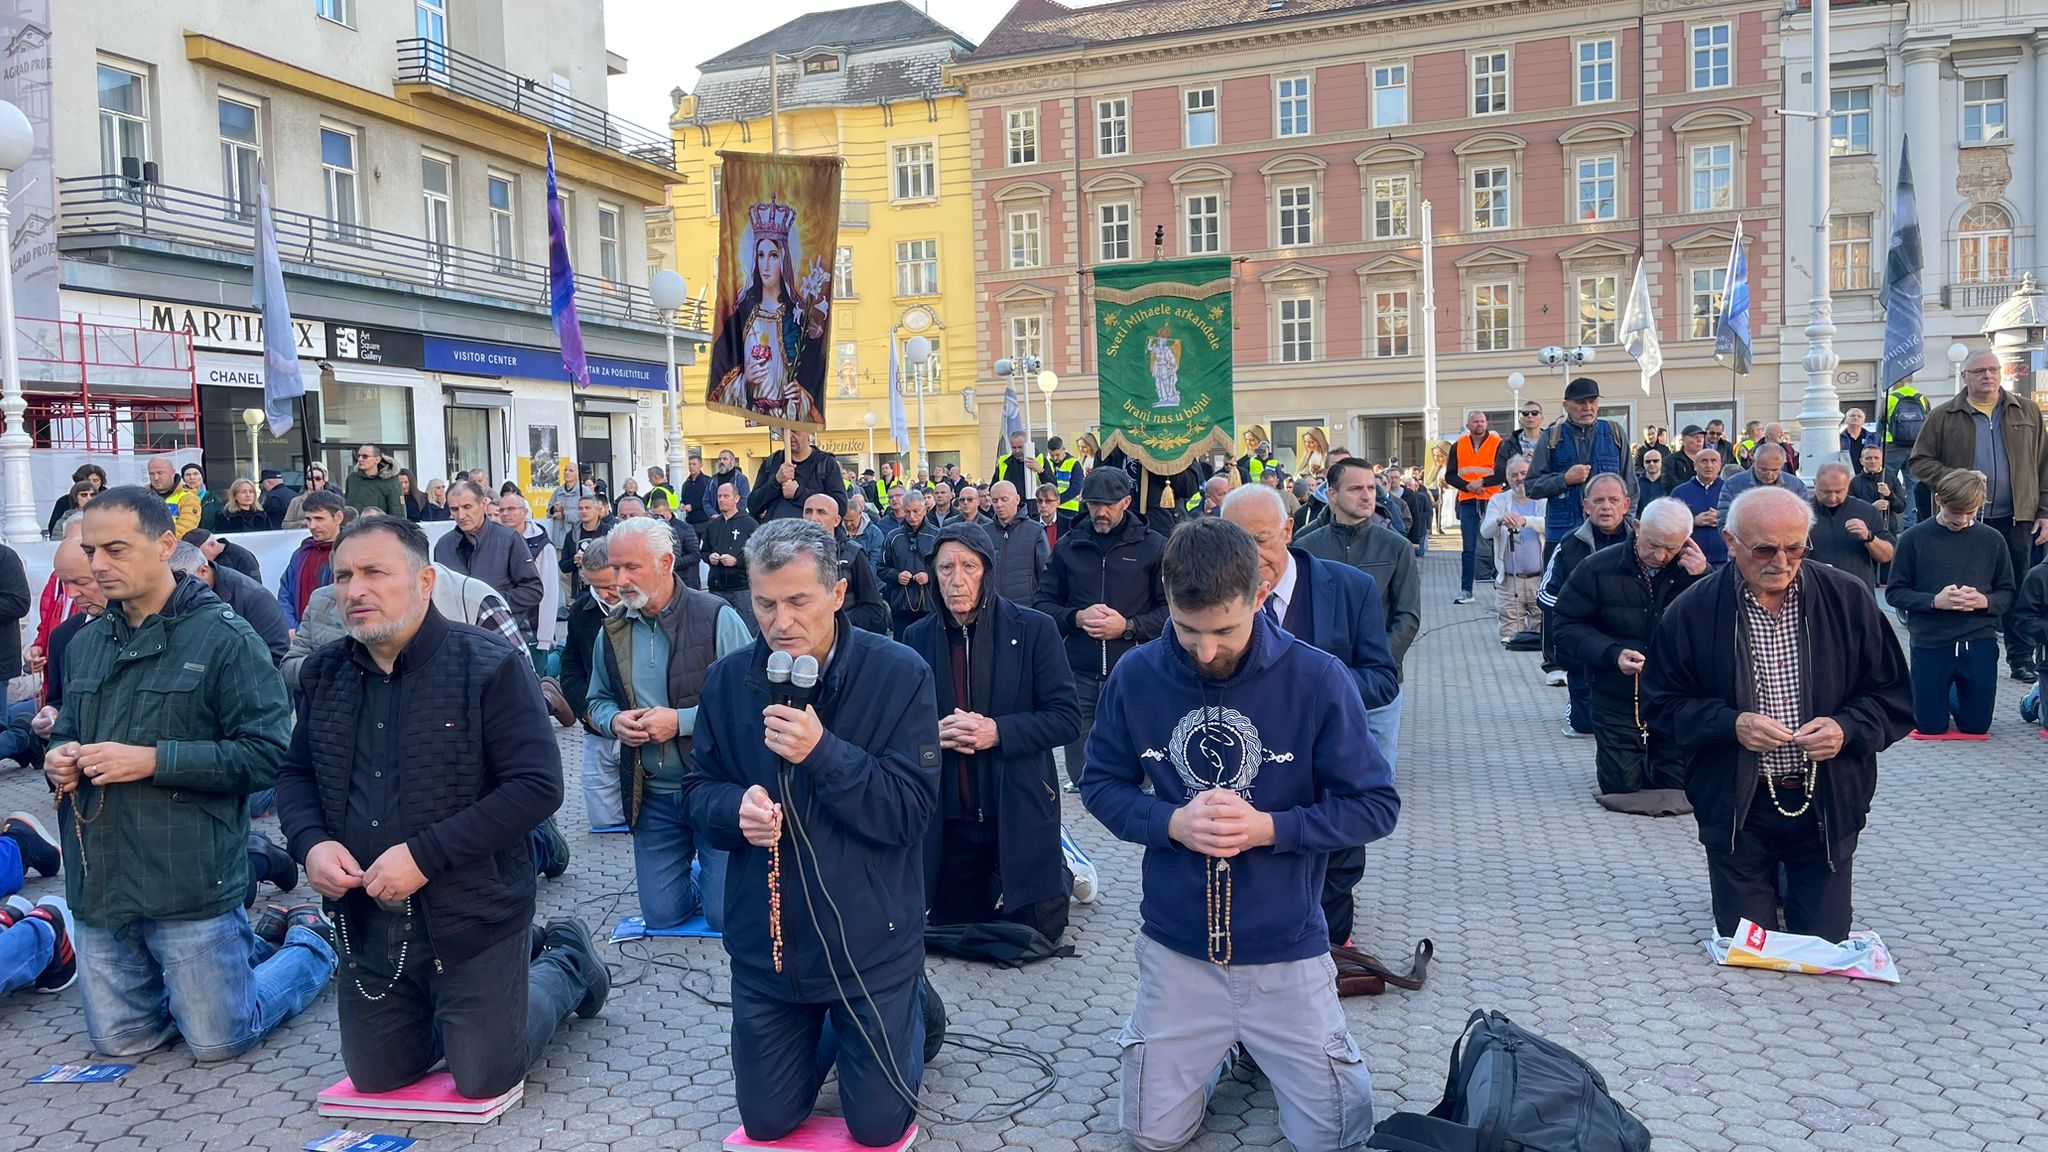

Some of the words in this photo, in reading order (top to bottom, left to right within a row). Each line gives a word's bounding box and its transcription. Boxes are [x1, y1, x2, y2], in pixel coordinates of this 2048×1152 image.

[360, 330, 370, 340] Art
[1106, 326, 1128, 357] Sveti
[1125, 304, 1171, 328] Mihaele
[360, 340, 380, 351] Square
[360, 350, 382, 363] Gallery
[453, 350, 486, 363] VISITOR
[488, 355, 517, 366] CENTER
[209, 370, 263, 385] CHANEL
[601, 367, 610, 376] ZA
[611, 368, 650, 380] POSJETITELJE
[1123, 398, 1151, 422] brani
[1153, 414, 1173, 424] nas
[1175, 413, 1184, 421] u
